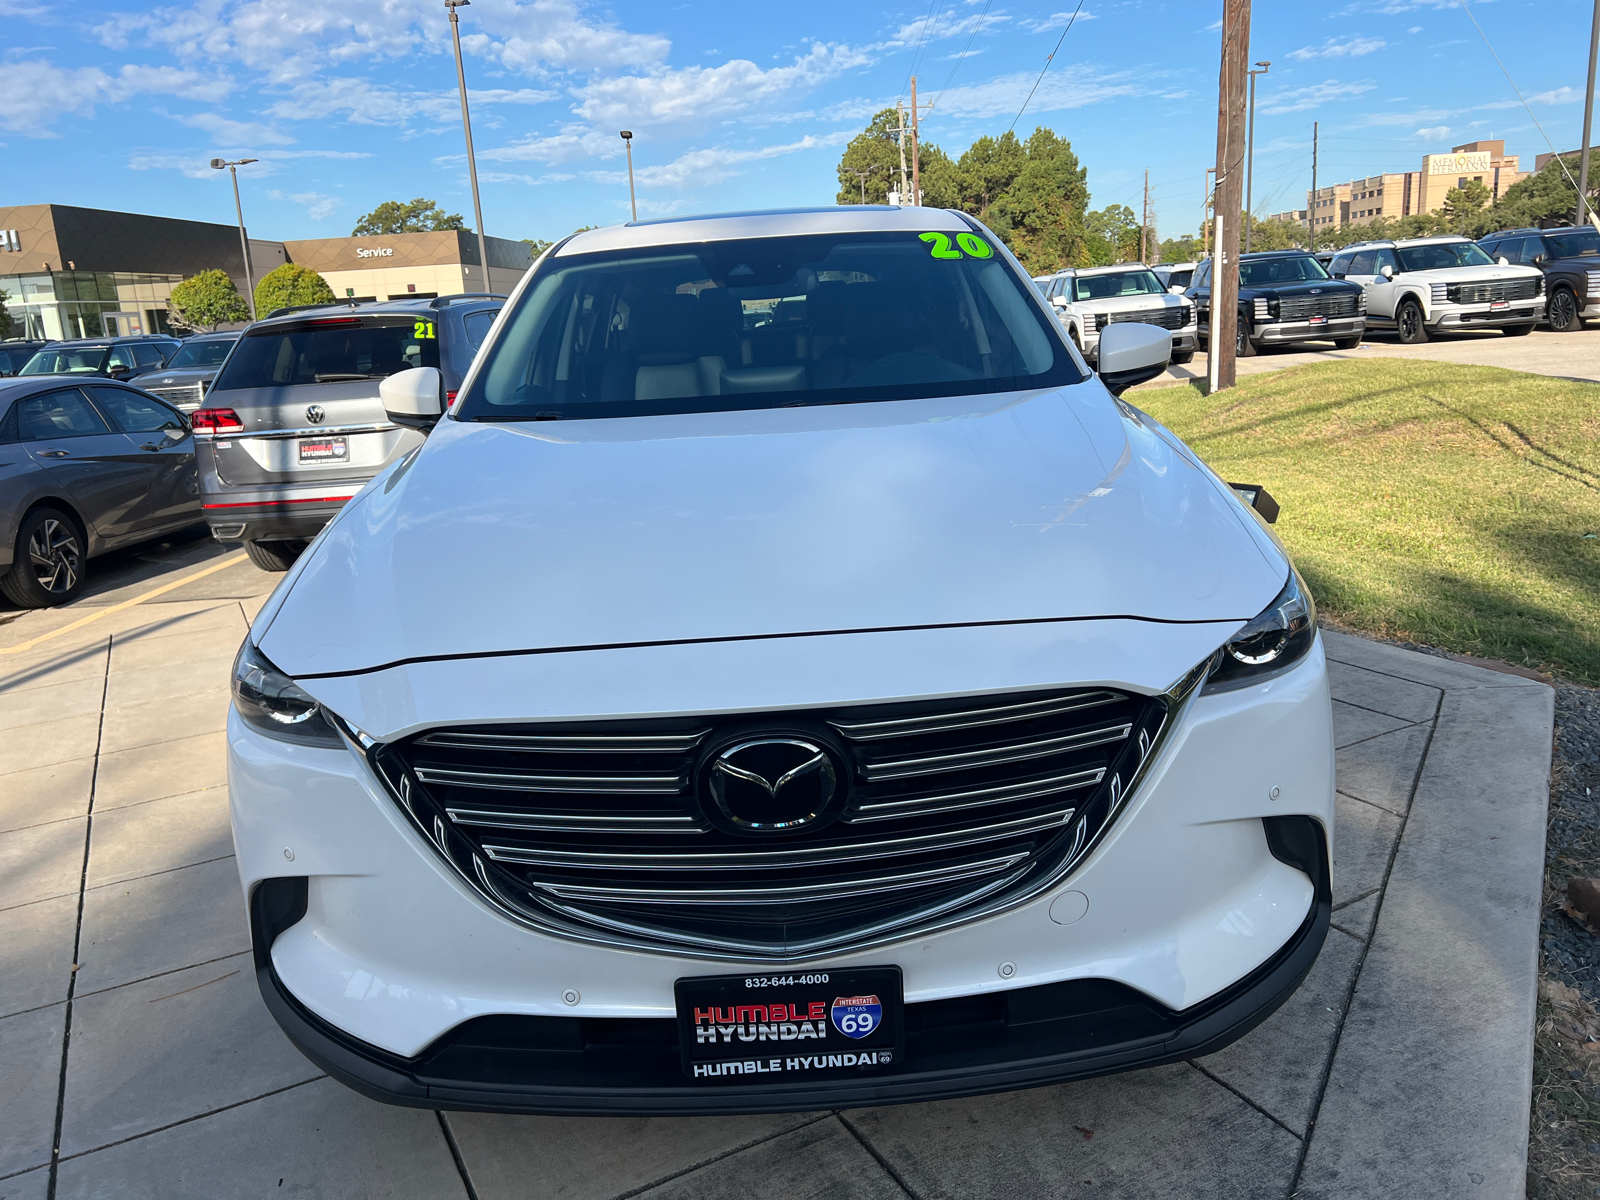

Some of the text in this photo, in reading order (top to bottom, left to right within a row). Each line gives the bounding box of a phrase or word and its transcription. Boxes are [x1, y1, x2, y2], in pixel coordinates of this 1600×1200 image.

[1432, 162, 1488, 174] HERMANN
[1433, 155, 1488, 167] MEMORIAL
[356, 247, 393, 258] Service
[917, 232, 994, 259] 20
[414, 322, 435, 339] 21
[301, 444, 333, 452] HUMBLE
[745, 974, 829, 988] 832-644-4000
[839, 997, 874, 1006] INTERSTATE
[694, 1001, 827, 1024] HUMBLE
[841, 1014, 873, 1033] 69
[696, 1021, 827, 1044] HYUNDAI
[693, 1052, 877, 1078] HUMBLE HYUNDAI
